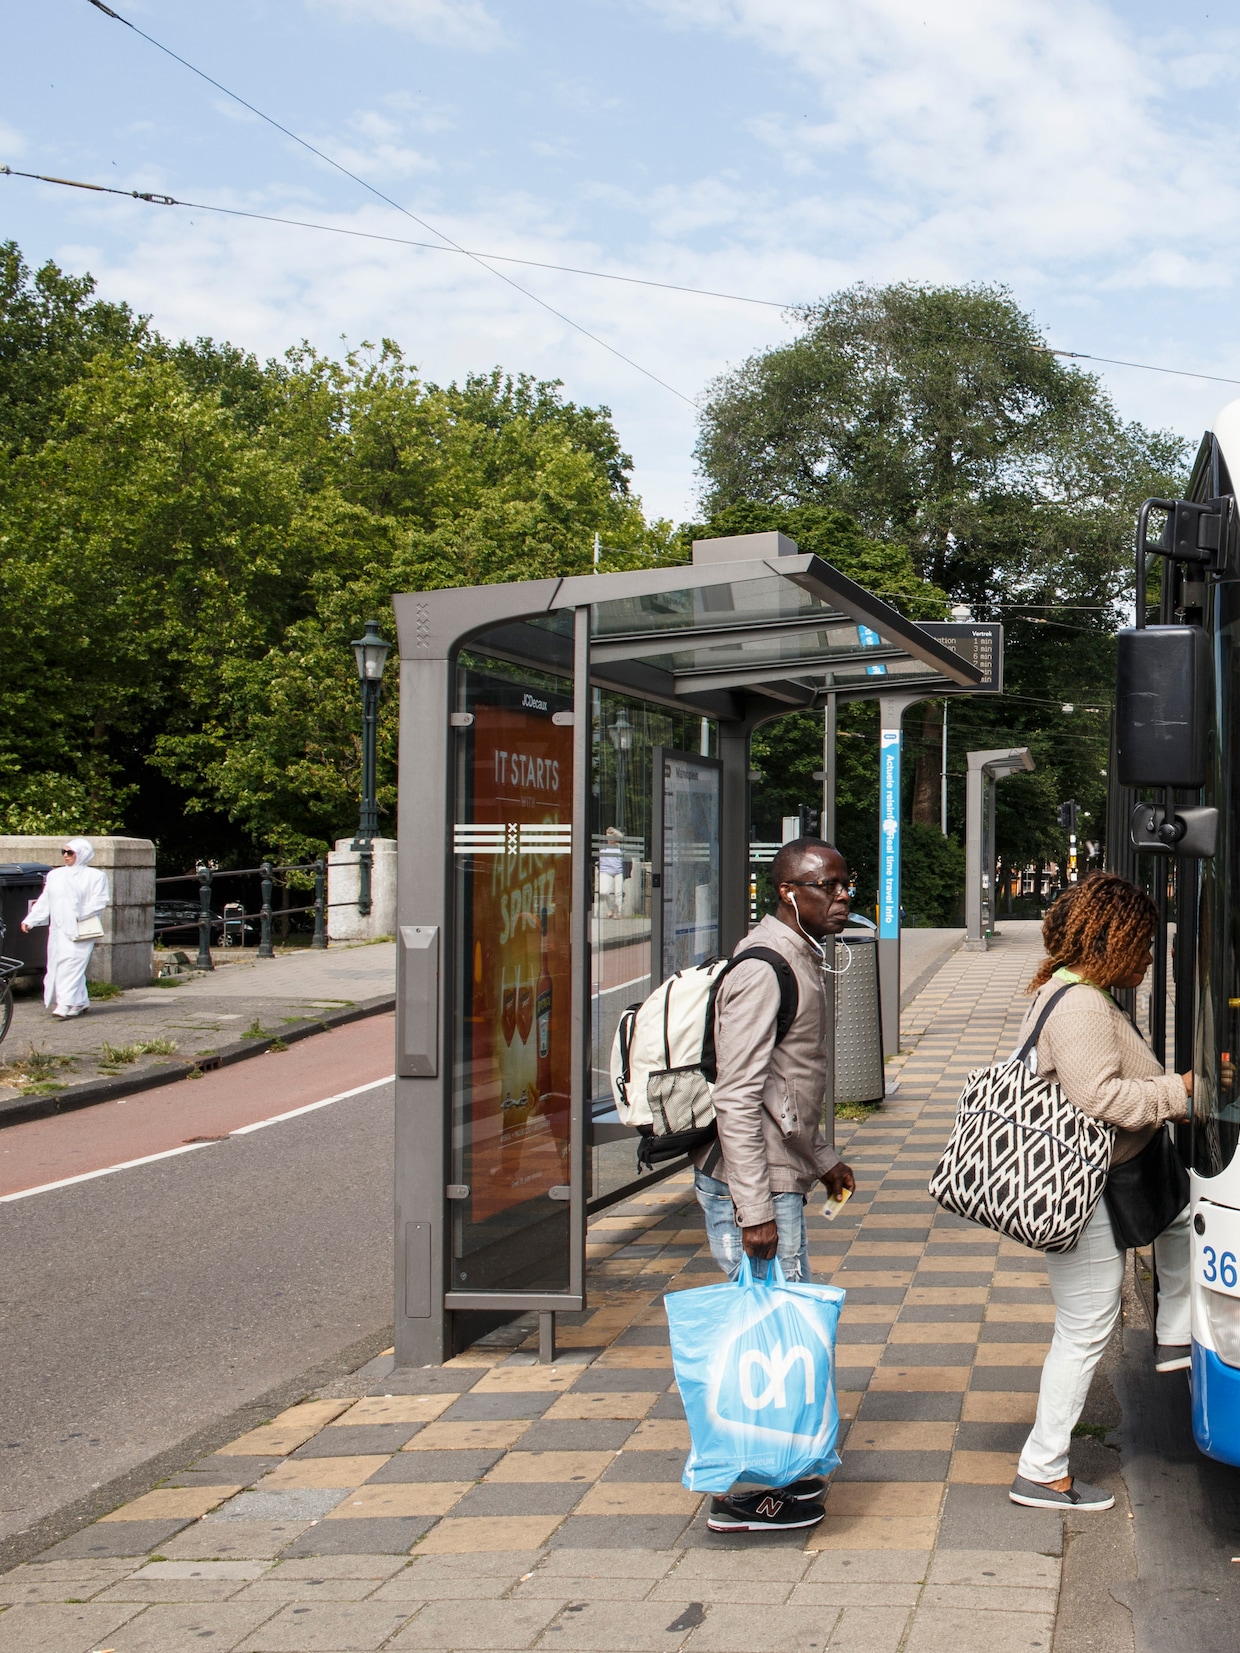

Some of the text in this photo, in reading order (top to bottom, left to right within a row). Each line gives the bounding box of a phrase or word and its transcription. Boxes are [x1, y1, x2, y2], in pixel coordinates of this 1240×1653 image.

[980, 660, 993, 668] min
[521, 693, 548, 711] JCDecaux
[495, 750, 560, 792] IT STARTS
[885, 754, 895, 823] Actuele reisinf
[885, 832, 895, 854] Real
[885, 857, 895, 876] time
[885, 879, 895, 905] travel
